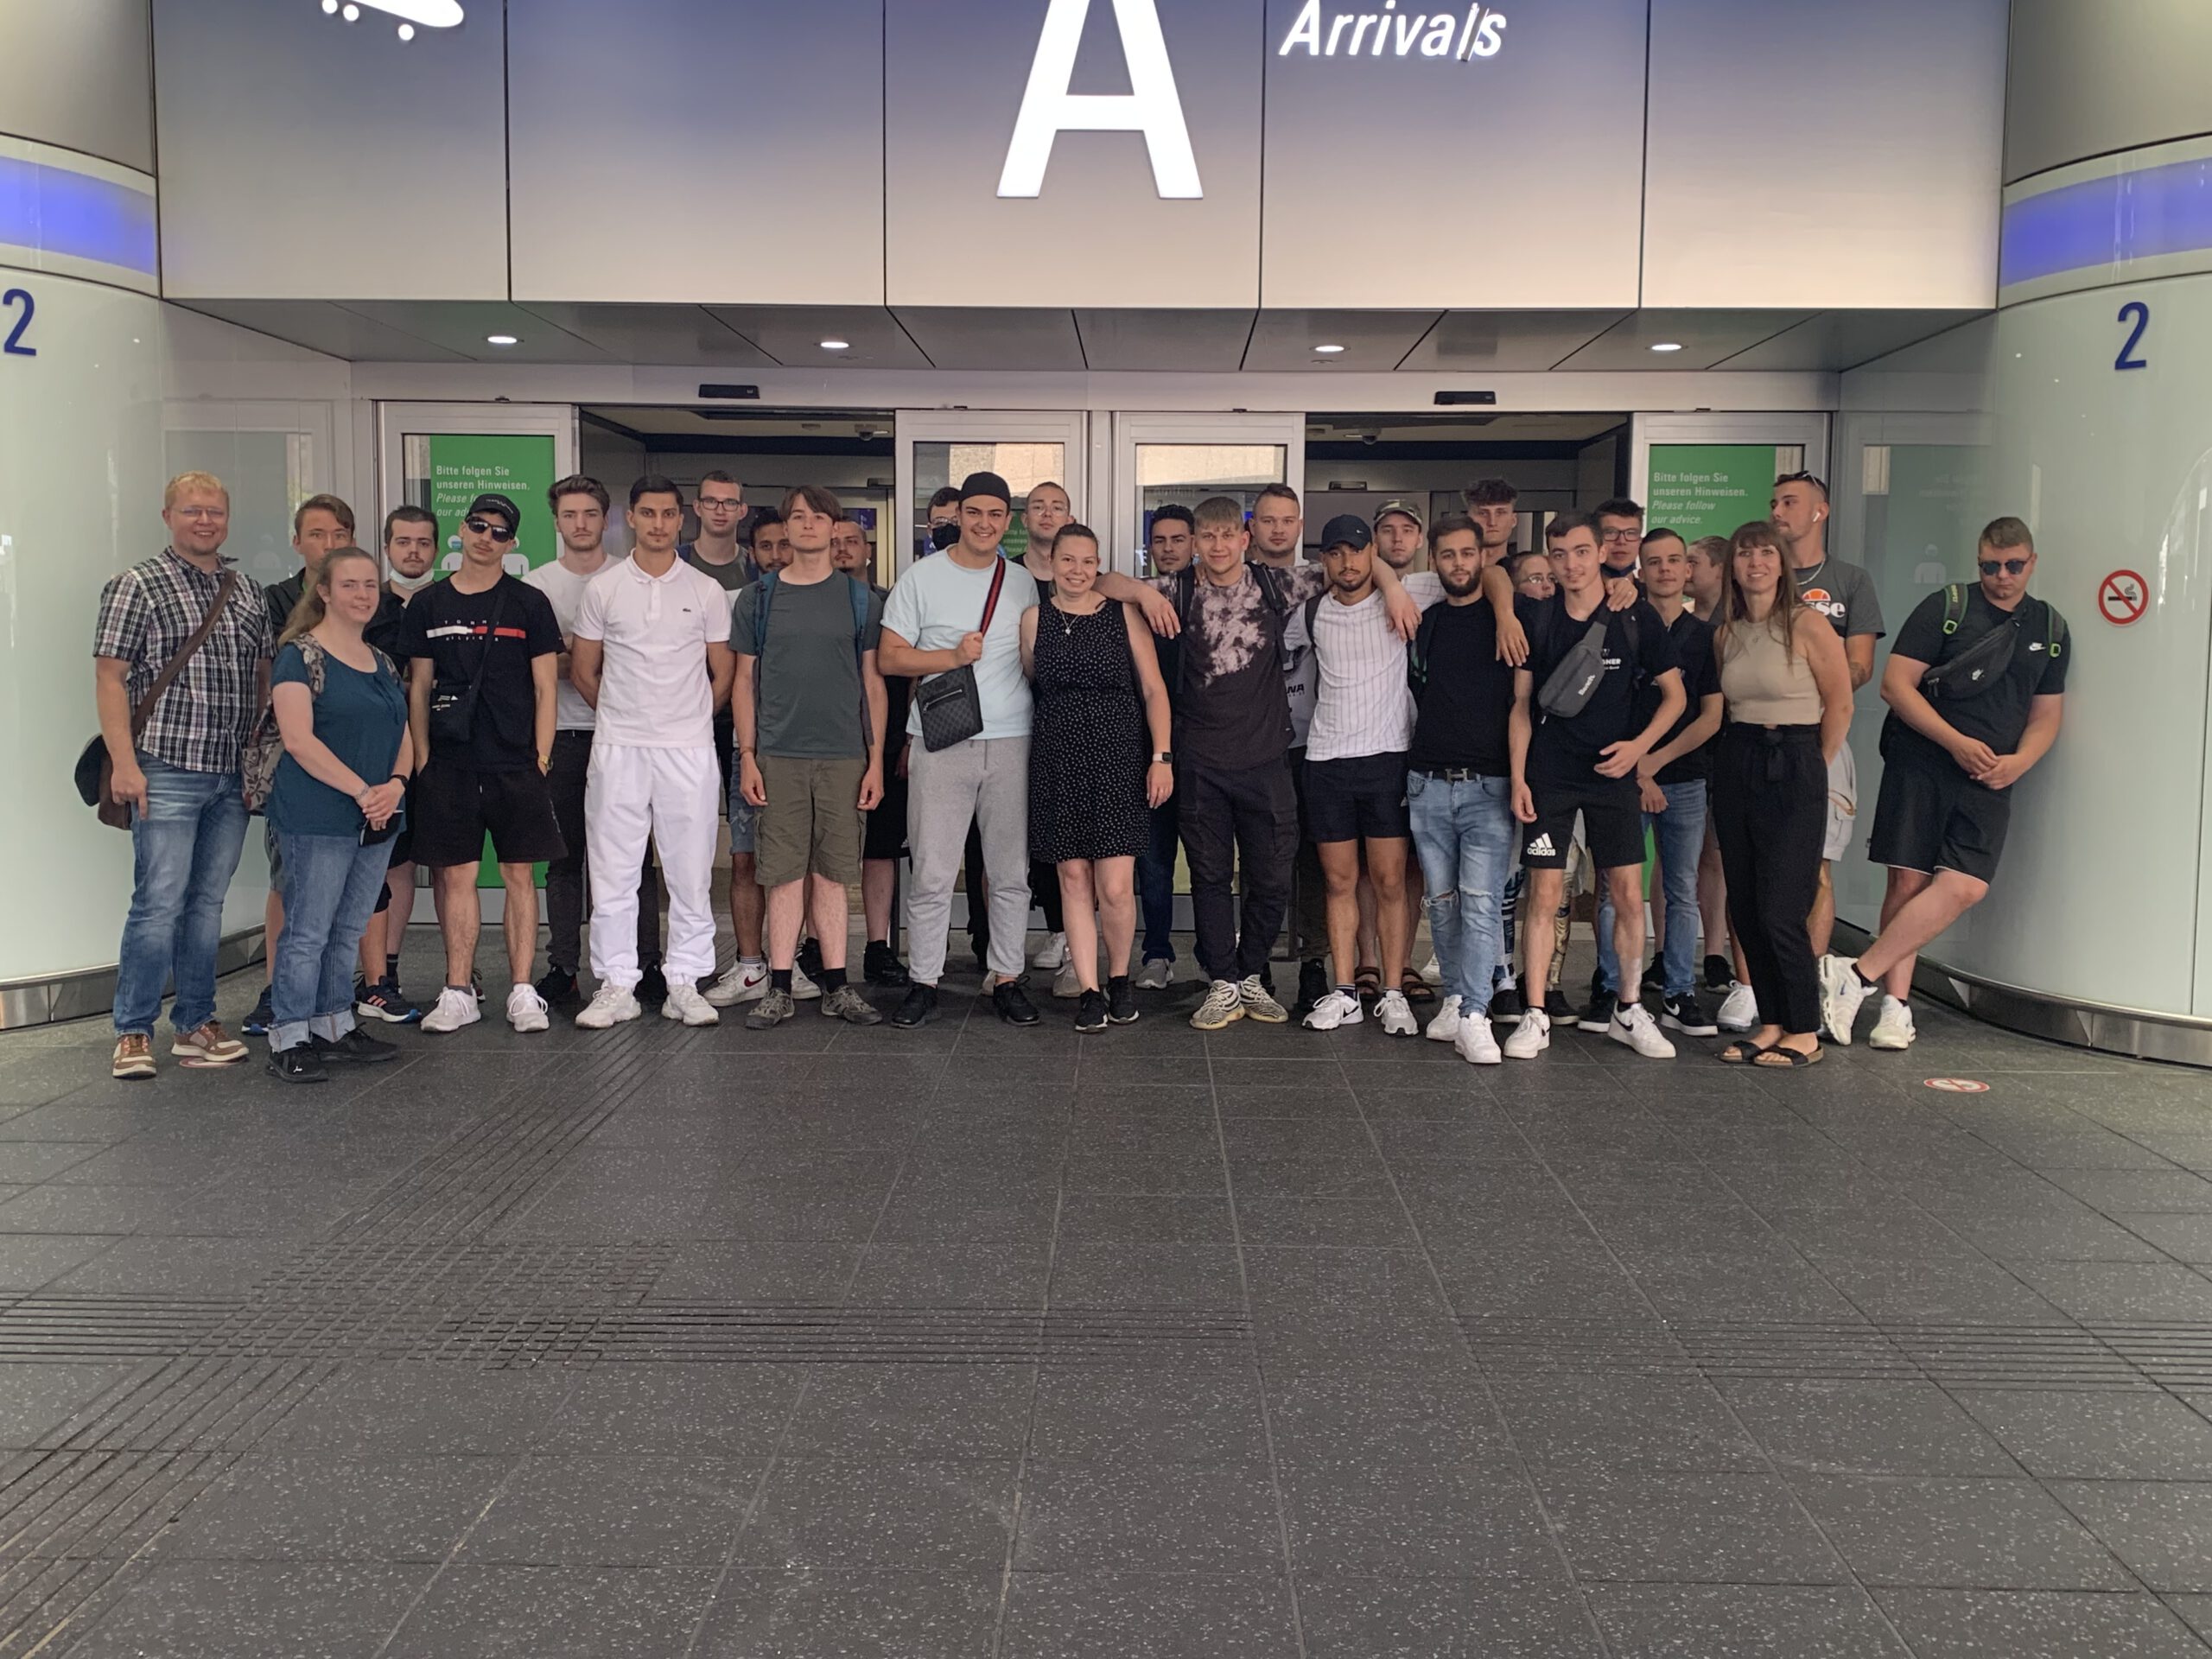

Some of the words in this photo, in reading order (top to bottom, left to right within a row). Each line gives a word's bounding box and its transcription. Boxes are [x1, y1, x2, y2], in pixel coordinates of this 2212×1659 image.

[1278, 0, 1508, 60] Arrivals
[996, 0, 1204, 200] A
[3, 288, 37, 357] 2
[2114, 301, 2150, 371] 2
[436, 466, 459, 475] Bitte
[462, 465, 492, 478] folgen
[494, 466, 510, 476] Sie
[1654, 472, 1677, 482] Bitte
[1680, 472, 1710, 485] folgen
[1713, 472, 1729, 482] Sie
[436, 480, 474, 490] unseren
[1653, 487, 1692, 497] unseren
[1694, 486, 1749, 497] Hinweisen.
[436, 493, 467, 503] Please
[1651, 500, 1684, 510] Please
[1686, 500, 1716, 510] follow
[436, 508, 452, 517] our
[1651, 515, 1668, 524] our
[1669, 514, 1703, 524] advice.
[1527, 847, 1556, 857] adidas
